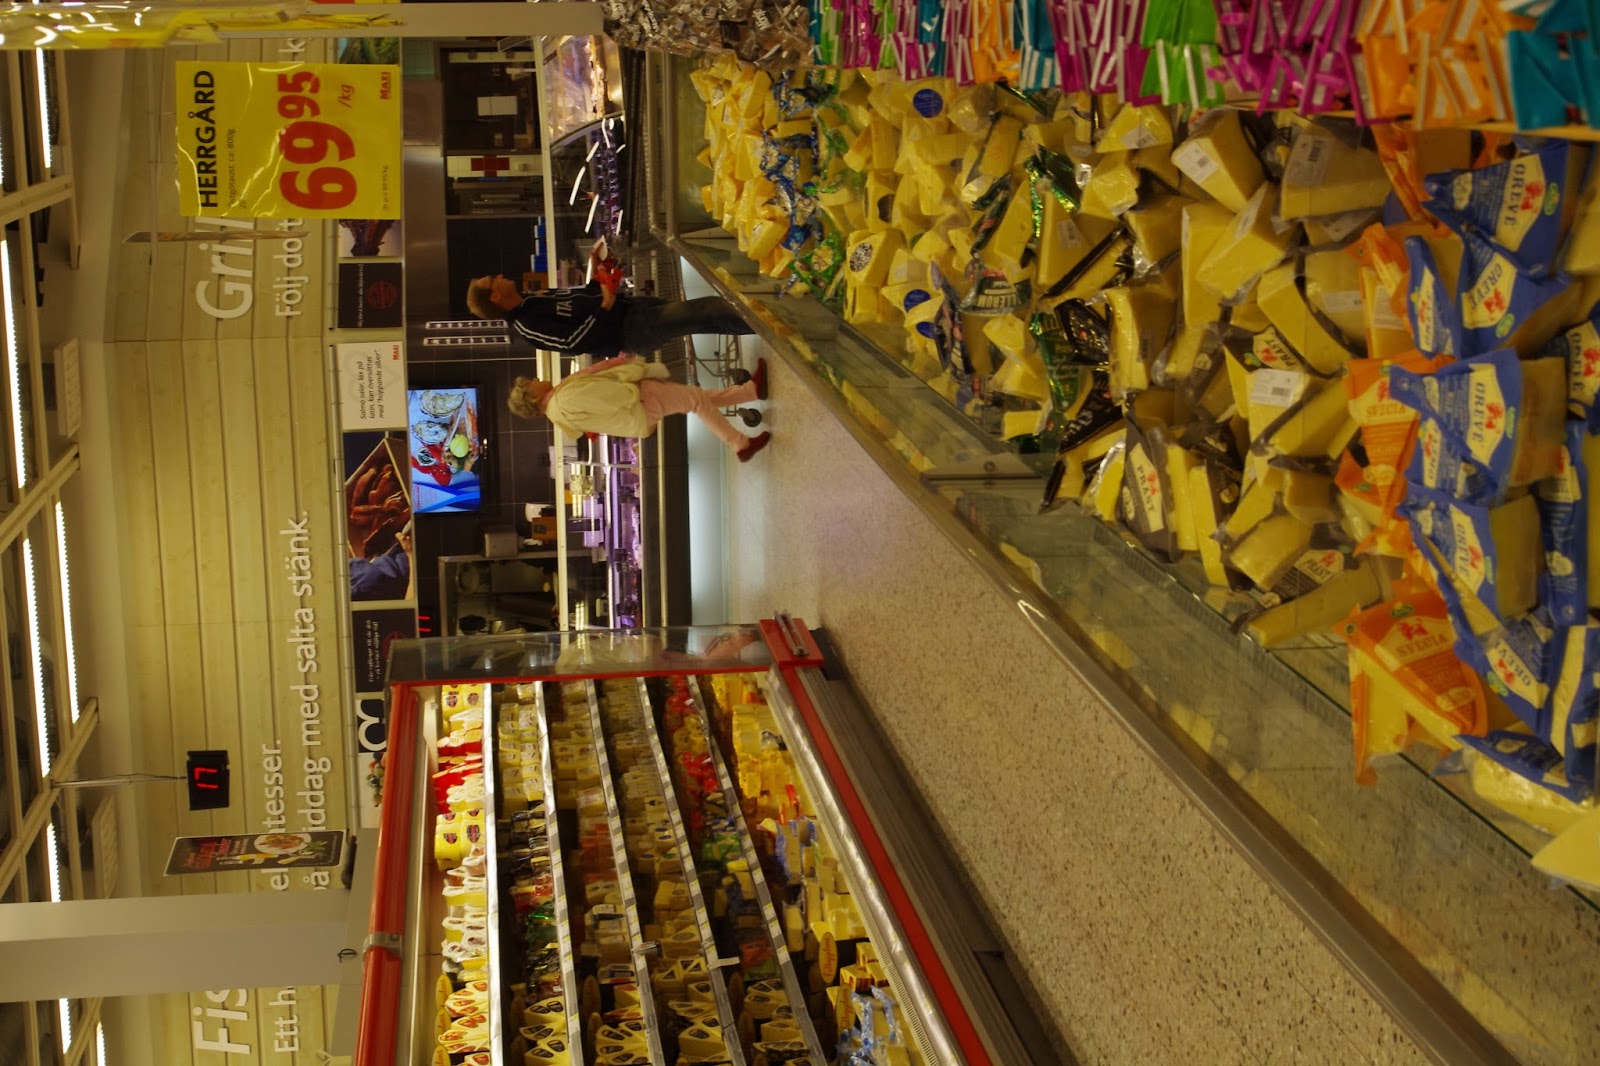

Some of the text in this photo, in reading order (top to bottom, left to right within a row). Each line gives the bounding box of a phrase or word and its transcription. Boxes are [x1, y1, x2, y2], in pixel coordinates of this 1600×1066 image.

[336, 83, 354, 109] /kg
[187, 70, 218, 208] HERRGÅRD
[272, 275, 309, 317] Följ
[279, 510, 314, 597] stänk.
[287, 607, 318, 673] salta
[290, 684, 322, 746] med
[193, 765, 220, 790] 17
[297, 757, 332, 832] iddag
[274, 1015, 299, 1053] Ett
